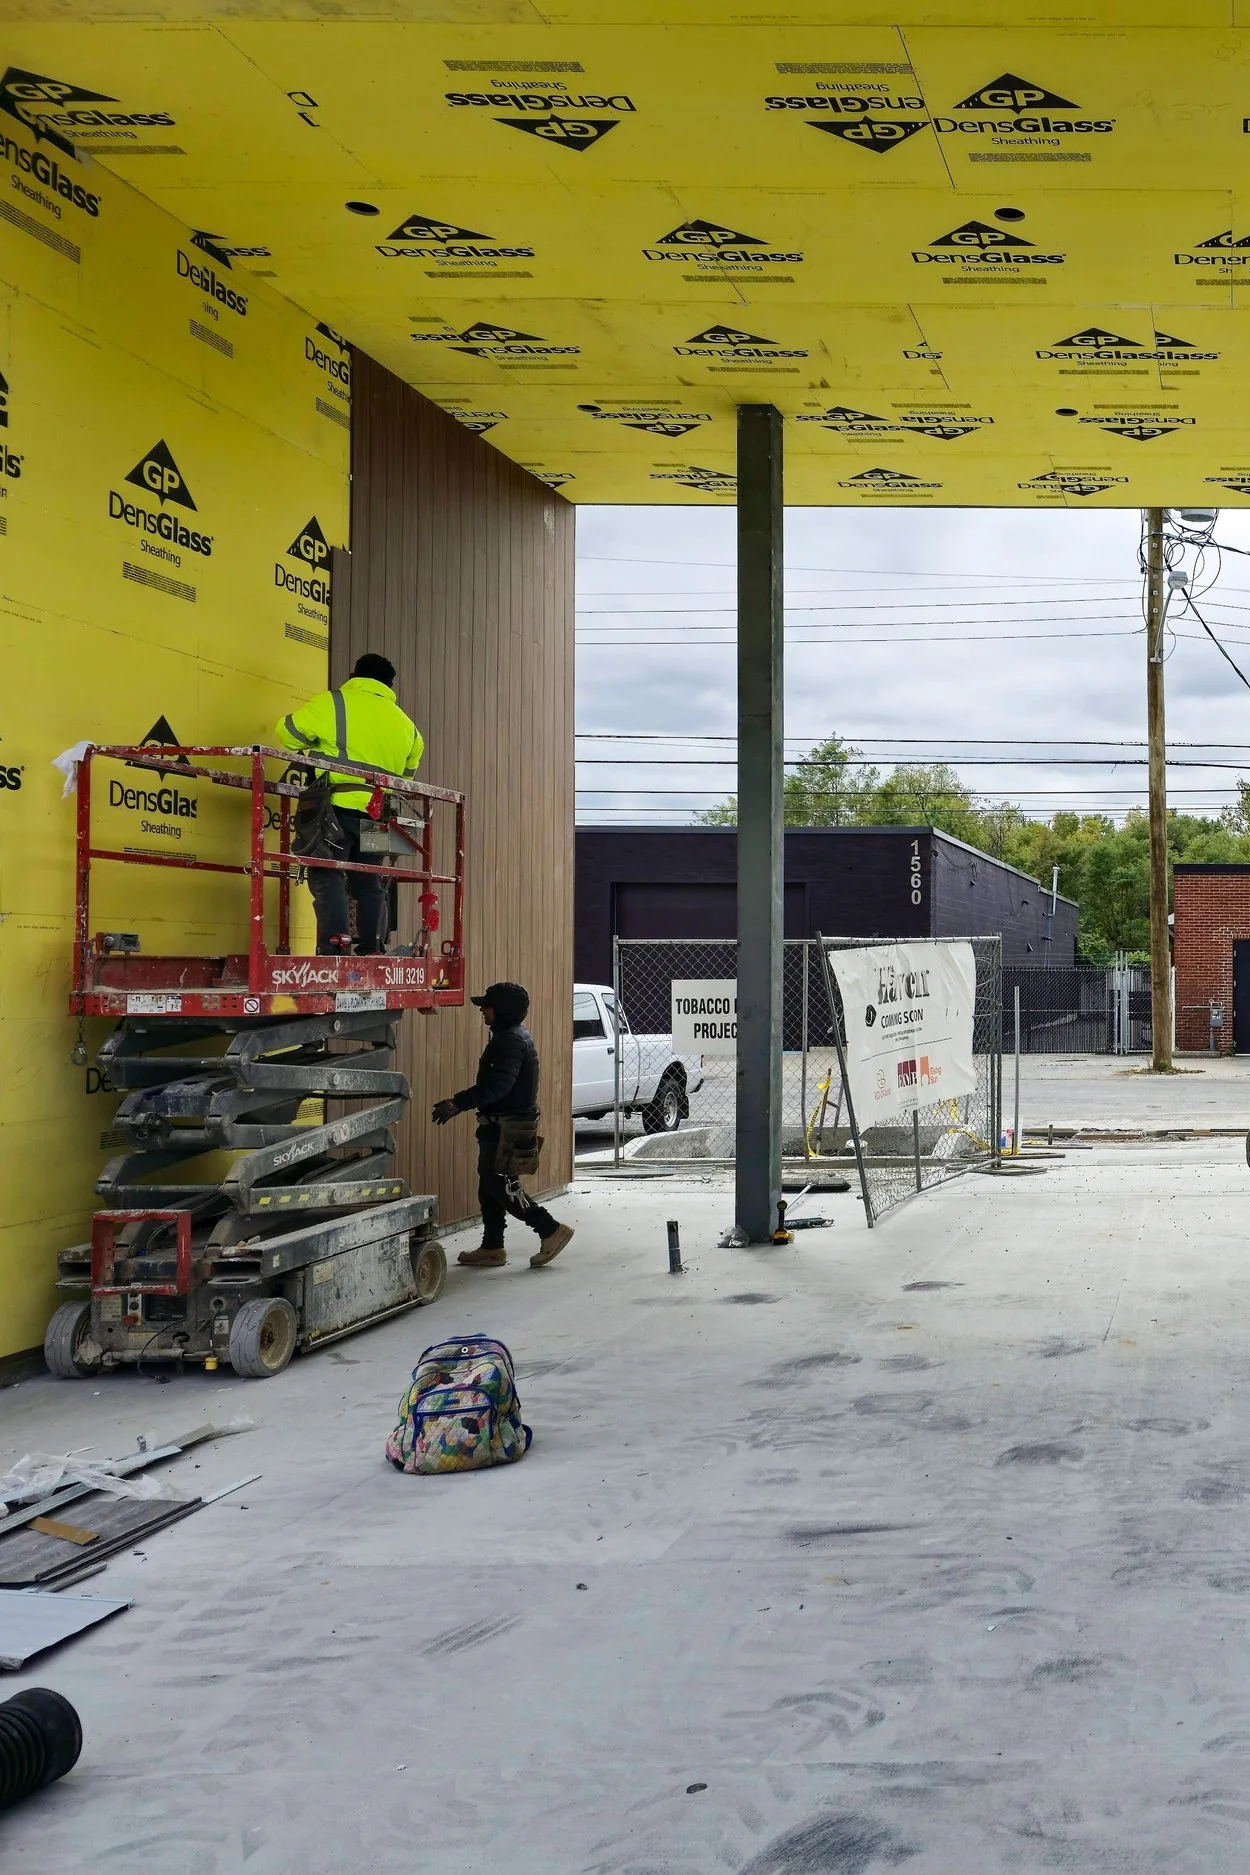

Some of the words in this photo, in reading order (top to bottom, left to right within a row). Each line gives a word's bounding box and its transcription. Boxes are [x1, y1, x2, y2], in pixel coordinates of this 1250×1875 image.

[490, 80, 567, 90] Sheathing
[816, 82, 889, 92] Sheathing
[444, 93, 637, 112] DensGlass
[979, 89, 1045, 105] GP
[536, 120, 598, 138] GP
[843, 123, 905, 139] GP
[934, 117, 1114, 133] DensGlass
[63, 129, 137, 139] Sheathing
[991, 137, 1061, 146] Sheathing
[11, 174, 62, 220] Sheathing
[402, 225, 459, 239] GP
[675, 229, 738, 243] GP
[951, 232, 1006, 244] GP
[374, 245, 536, 258] DensGlass
[911, 252, 1065, 264] DensGlass
[436, 259, 498, 268] Sheathing
[703, 333, 750, 343] GP
[1072, 335, 1119, 346] GP
[673, 346, 808, 358] DensGlass
[591, 411, 713, 421] DensGlass
[1079, 416, 1196, 424] DensGlass
[143, 459, 180, 494] GP
[109, 490, 213, 557] DensGlass
[140, 538, 181, 568] Sheathing
[300, 535, 327, 562] GP
[297, 603, 327, 625] Sheathing
[141, 820, 181, 839] Sheathing
[910, 839, 922, 905] 1560
[272, 961, 338, 987] SKYJACK
[406, 967, 424, 984] 3219
[675, 998, 730, 1014] TOBACCO
[694, 1022, 738, 1039] PROJEC
[273, 1142, 314, 1166] SKYJACK
